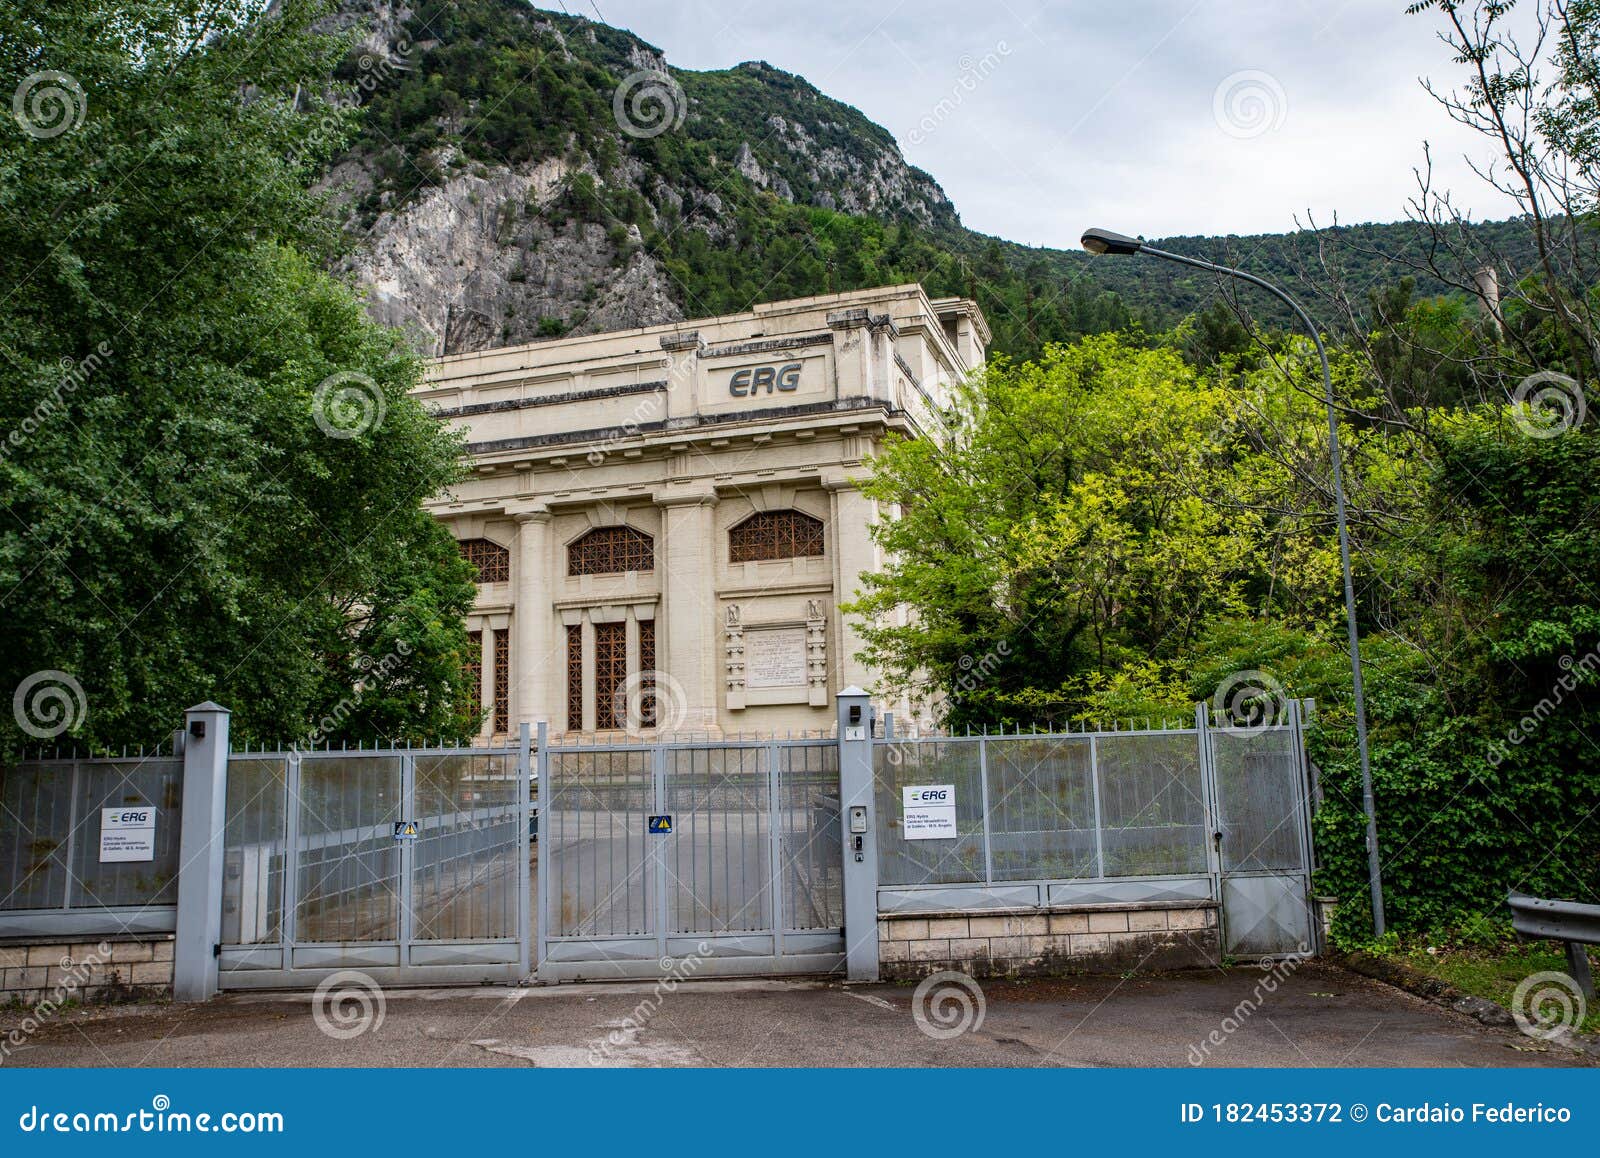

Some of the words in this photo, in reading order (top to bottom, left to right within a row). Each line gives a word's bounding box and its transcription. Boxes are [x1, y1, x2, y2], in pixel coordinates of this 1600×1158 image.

[729, 363, 802, 397] ERG
[922, 790, 947, 800] ERG
[121, 812, 148, 822] ERG
